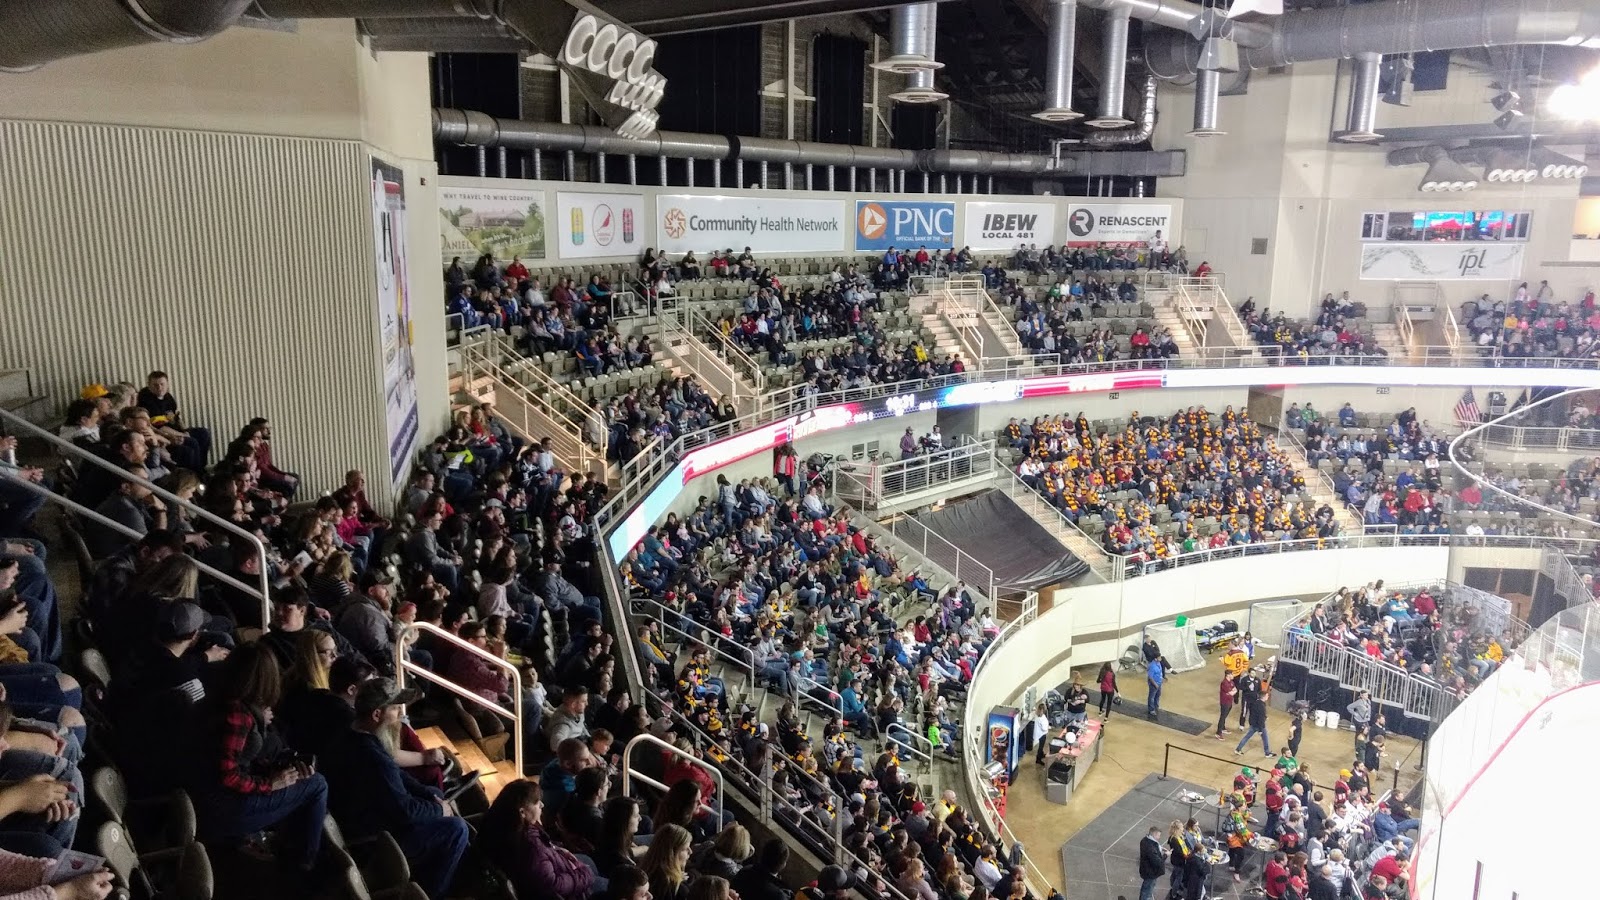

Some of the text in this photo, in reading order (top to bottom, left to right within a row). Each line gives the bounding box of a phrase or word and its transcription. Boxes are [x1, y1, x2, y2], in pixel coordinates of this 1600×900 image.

[689, 215, 838, 235] Community Health Network
[891, 208, 954, 236] PNC
[983, 214, 1038, 231] IBEW
[1099, 216, 1167, 226] RENASCENT
[1235, 657, 1242, 669] 8
